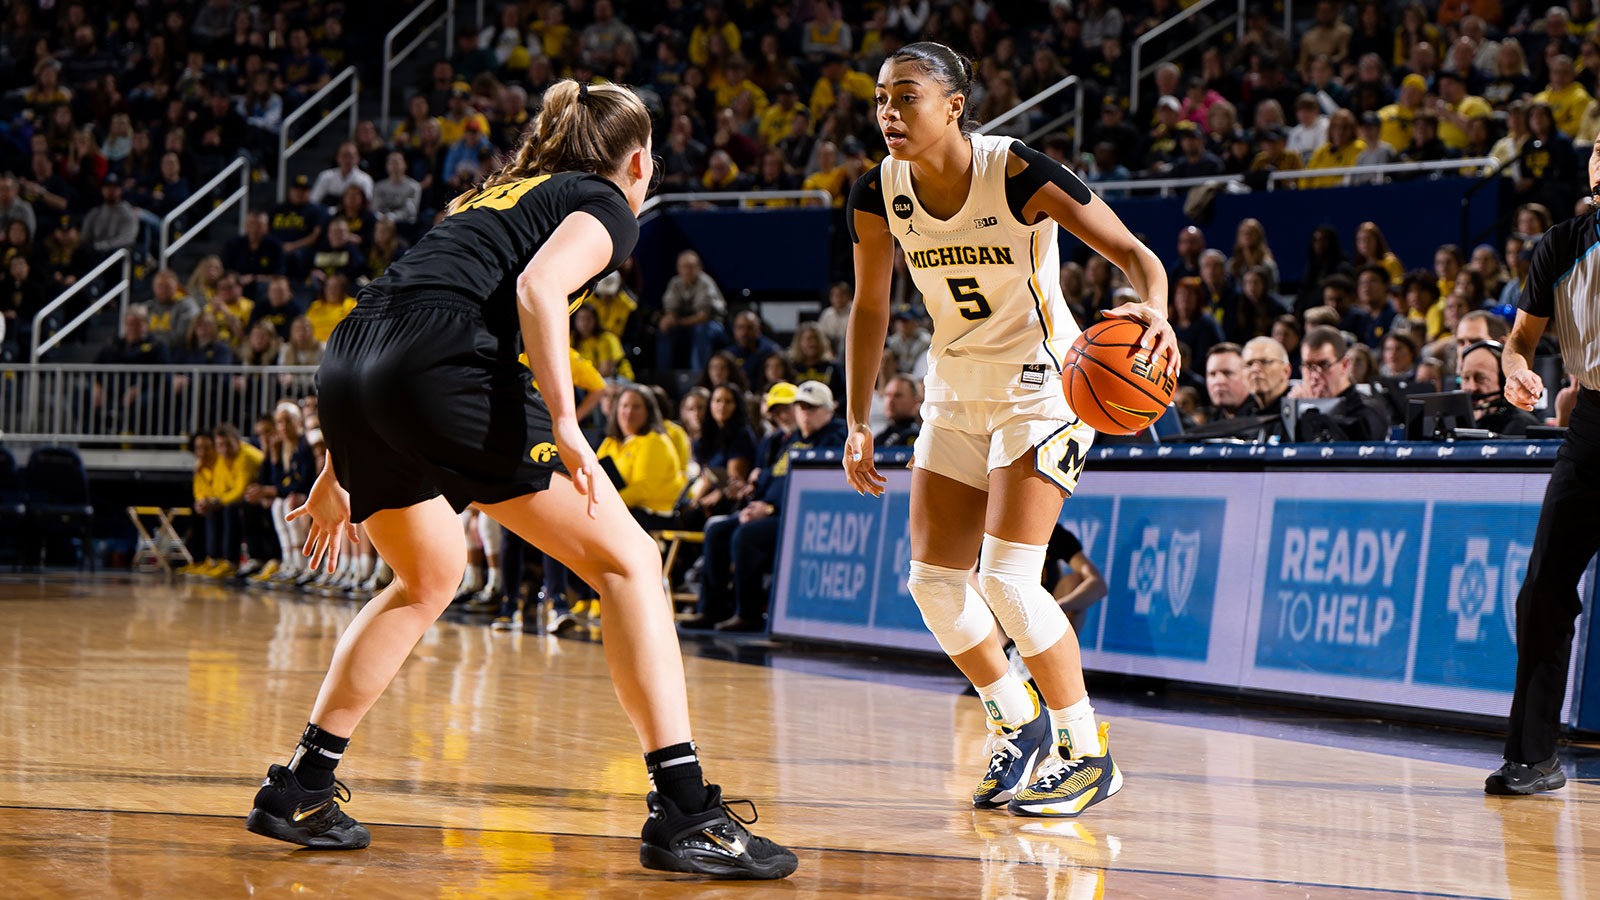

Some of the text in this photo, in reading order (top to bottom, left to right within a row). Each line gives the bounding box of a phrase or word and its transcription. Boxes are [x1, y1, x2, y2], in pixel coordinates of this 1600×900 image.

[894, 203, 911, 212] BLM
[907, 246, 1015, 269] MICHIGAN
[945, 276, 993, 321] 5
[1130, 353, 1176, 398] ELITE
[1057, 438, 1086, 482] M
[801, 511, 874, 556] READY
[1280, 526, 1406, 587] READY
[798, 560, 867, 600] TO HELP
[1278, 590, 1395, 647] TO HELP
